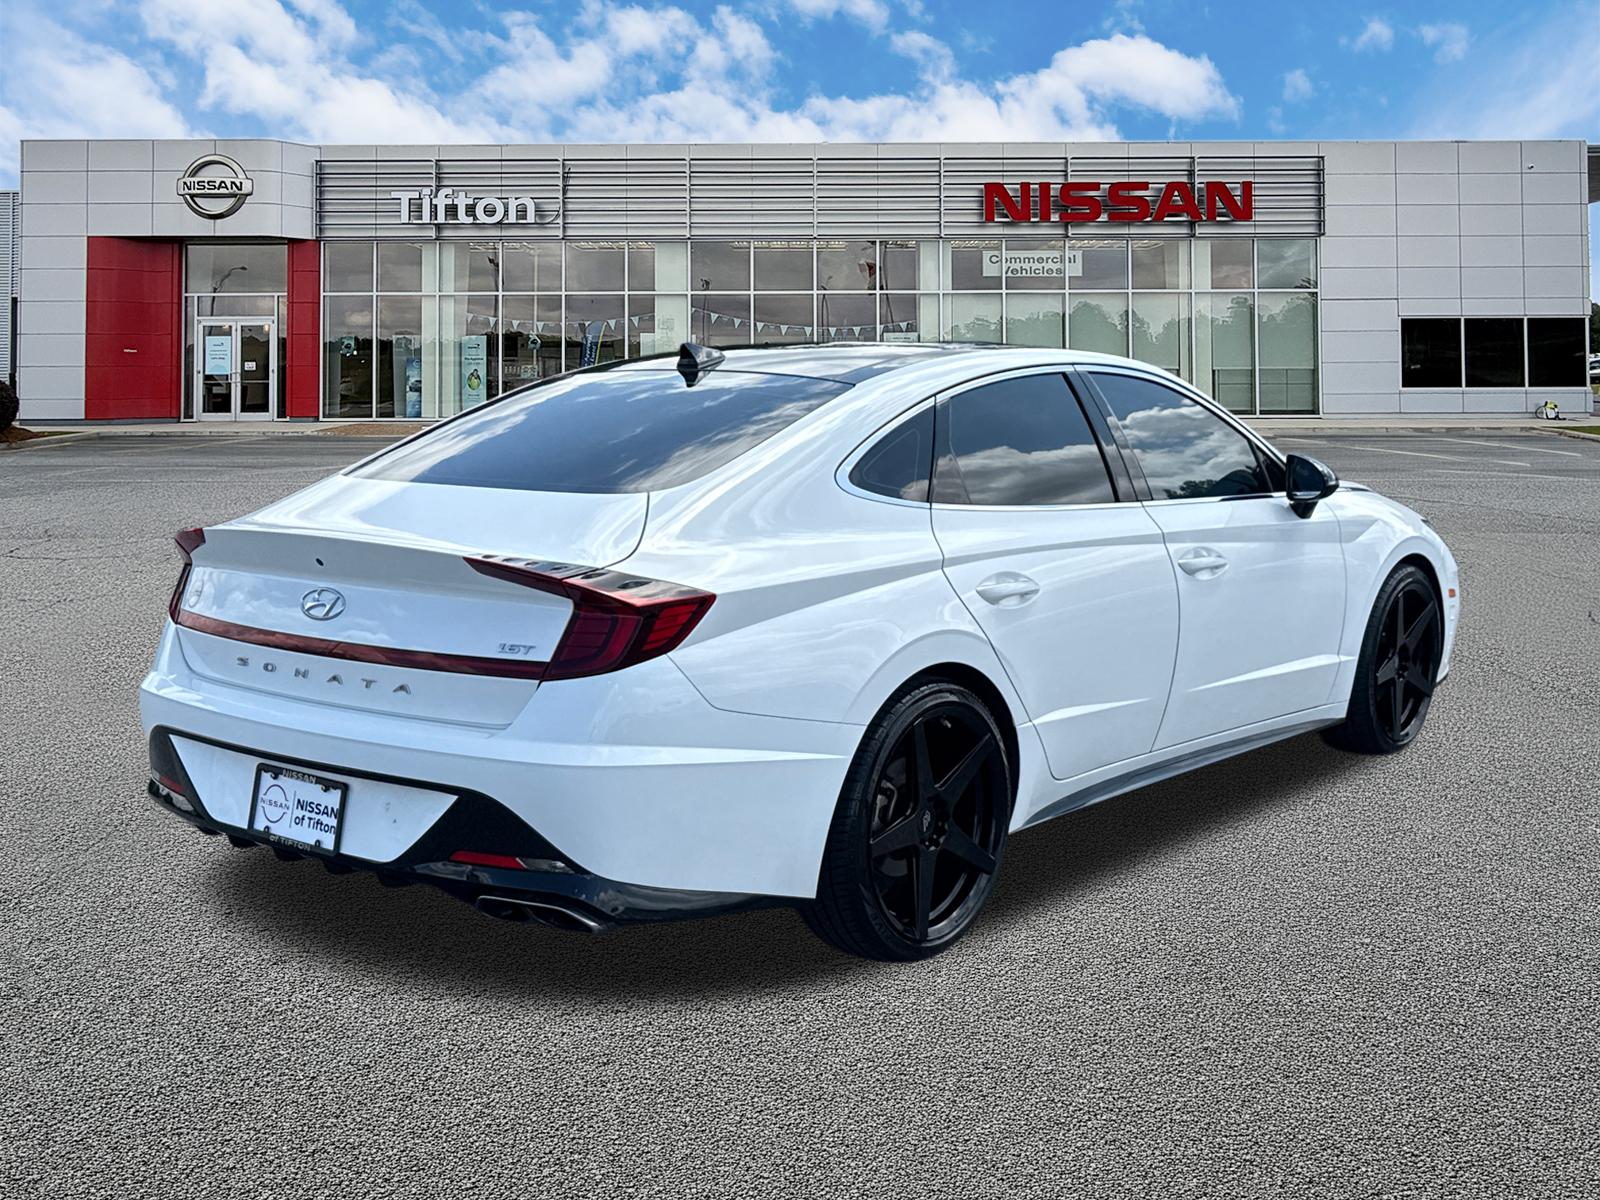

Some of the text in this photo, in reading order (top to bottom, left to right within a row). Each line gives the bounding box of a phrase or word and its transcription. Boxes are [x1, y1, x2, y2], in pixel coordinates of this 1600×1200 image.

[182, 180, 243, 191] NISSAN
[391, 188, 536, 224] Tifton
[983, 180, 1253, 222] NISSAN
[236, 656, 411, 695] SONATA
[282, 769, 317, 784] NISSAN
[260, 797, 289, 810] NISSAN
[296, 798, 338, 819] NISSAN
[293, 815, 336, 835] of Tifton
[280, 838, 311, 852] TIFTON
